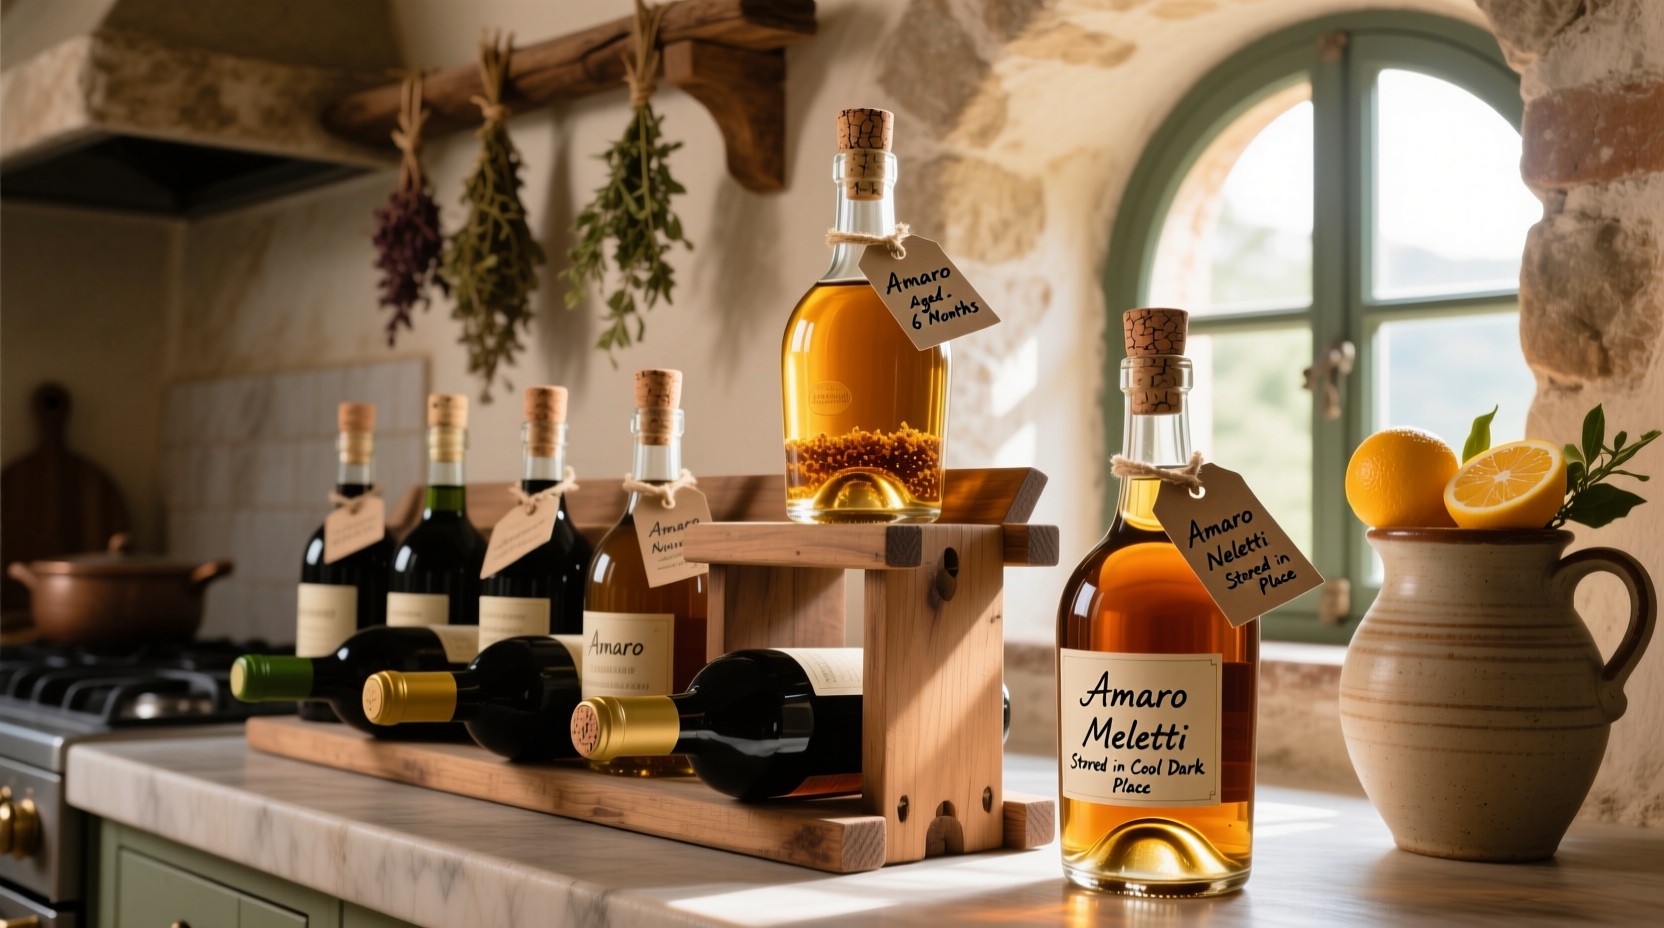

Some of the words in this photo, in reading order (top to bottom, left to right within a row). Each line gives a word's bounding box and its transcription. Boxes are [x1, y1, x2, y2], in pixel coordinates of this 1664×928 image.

[886, 267, 951, 295] Amaro
[912, 313, 922, 330] 6
[1189, 510, 1253, 549] Amaro
[1274, 555, 1290, 565] in
[588, 629, 644, 656] Amaro
[1079, 670, 1188, 708] Amaro
[1082, 716, 1189, 750] Meletti
[1113, 759, 1125, 773] in
[1130, 758, 1163, 776] Cool
[1167, 758, 1206, 776] Dark
